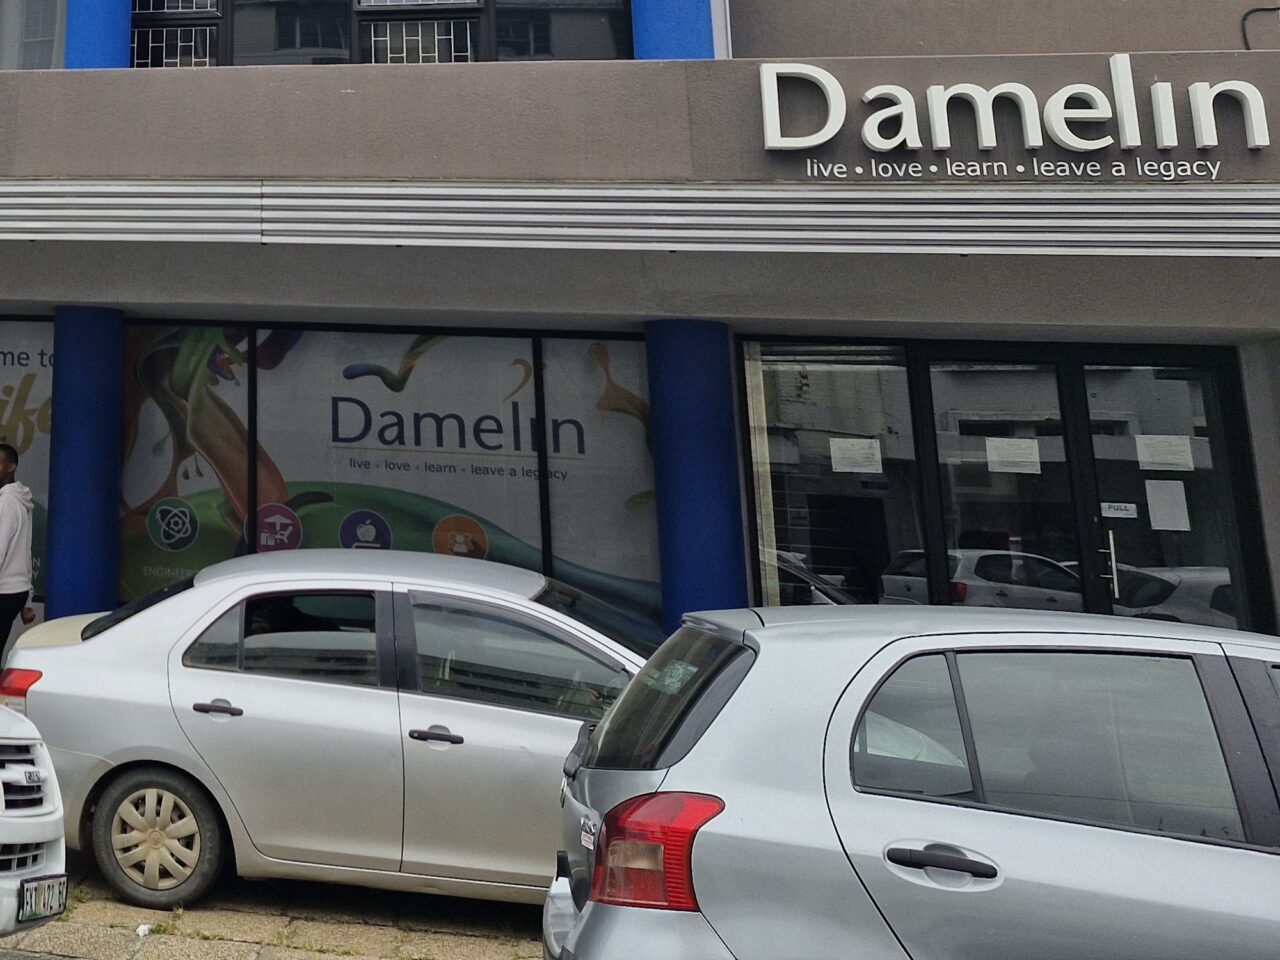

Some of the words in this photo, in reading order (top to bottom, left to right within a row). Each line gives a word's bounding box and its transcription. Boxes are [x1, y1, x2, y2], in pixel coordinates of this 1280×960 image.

[759, 53, 1271, 152] Damelin
[806, 158, 848, 178] live
[871, 158, 923, 177] love
[946, 157, 1008, 177] learn
[1032, 157, 1102, 177] leave
[1111, 161, 1127, 177] a
[1136, 157, 1222, 181] legacy
[331, 396, 586, 455] Damelin
[349, 458, 371, 470] live
[384, 459, 411, 471] love
[424, 461, 457, 473] learn
[471, 464, 505, 476] leave
[509, 468, 517, 477] a
